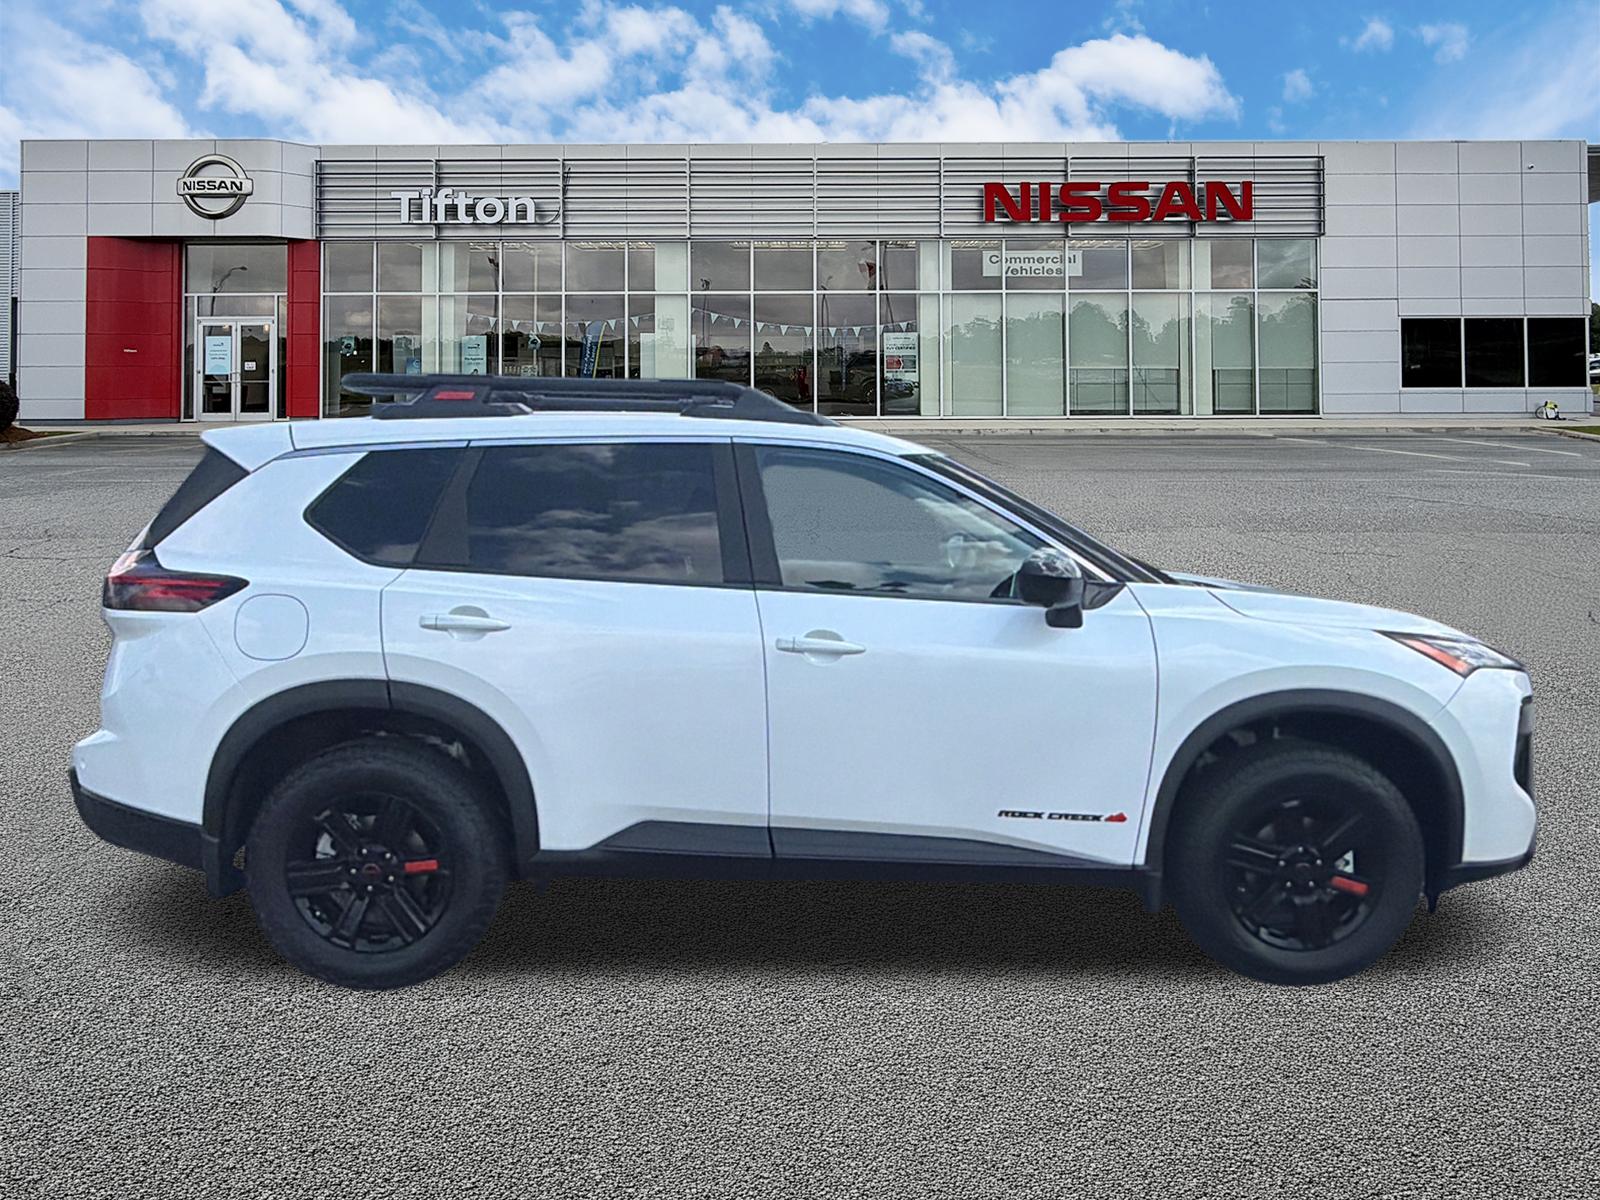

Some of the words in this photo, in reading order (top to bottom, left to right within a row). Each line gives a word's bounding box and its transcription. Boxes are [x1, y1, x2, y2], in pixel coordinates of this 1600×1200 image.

[182, 180, 243, 192] NISSAN
[390, 187, 536, 224] Tifton
[983, 180, 1254, 222] NISSAN
[997, 809, 1045, 820] ROCK
[1046, 811, 1105, 823] CREEK
